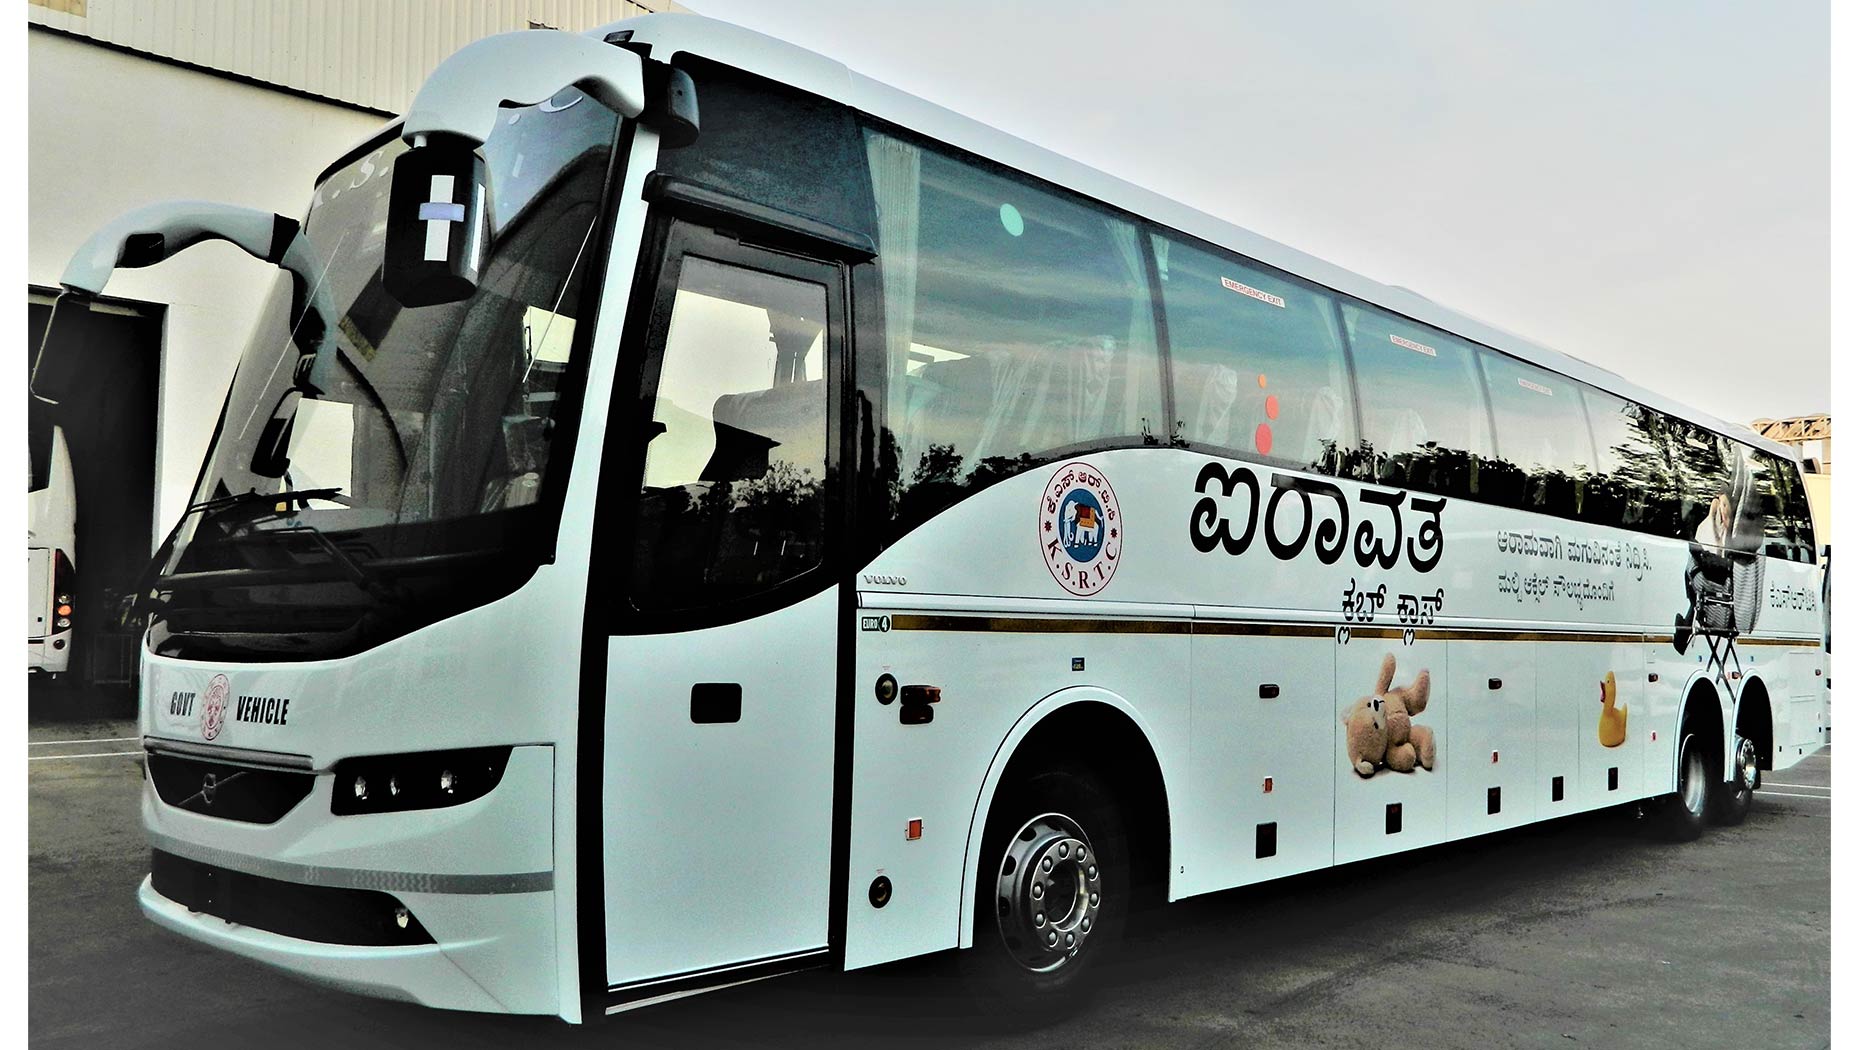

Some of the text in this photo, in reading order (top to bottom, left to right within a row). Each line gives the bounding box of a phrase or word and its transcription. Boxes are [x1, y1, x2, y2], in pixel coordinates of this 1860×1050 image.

[1224, 279, 1281, 305] EMERGENCY EXIT
[1190, 462, 1447, 573] ಐರಾವತ
[1497, 529, 1563, 560] ಆರಾಮವಾಗಿ
[863, 574, 908, 586] VOLVO
[862, 618, 879, 629] EURO
[170, 691, 196, 717] GOVT
[236, 695, 290, 726] VEHICLE
